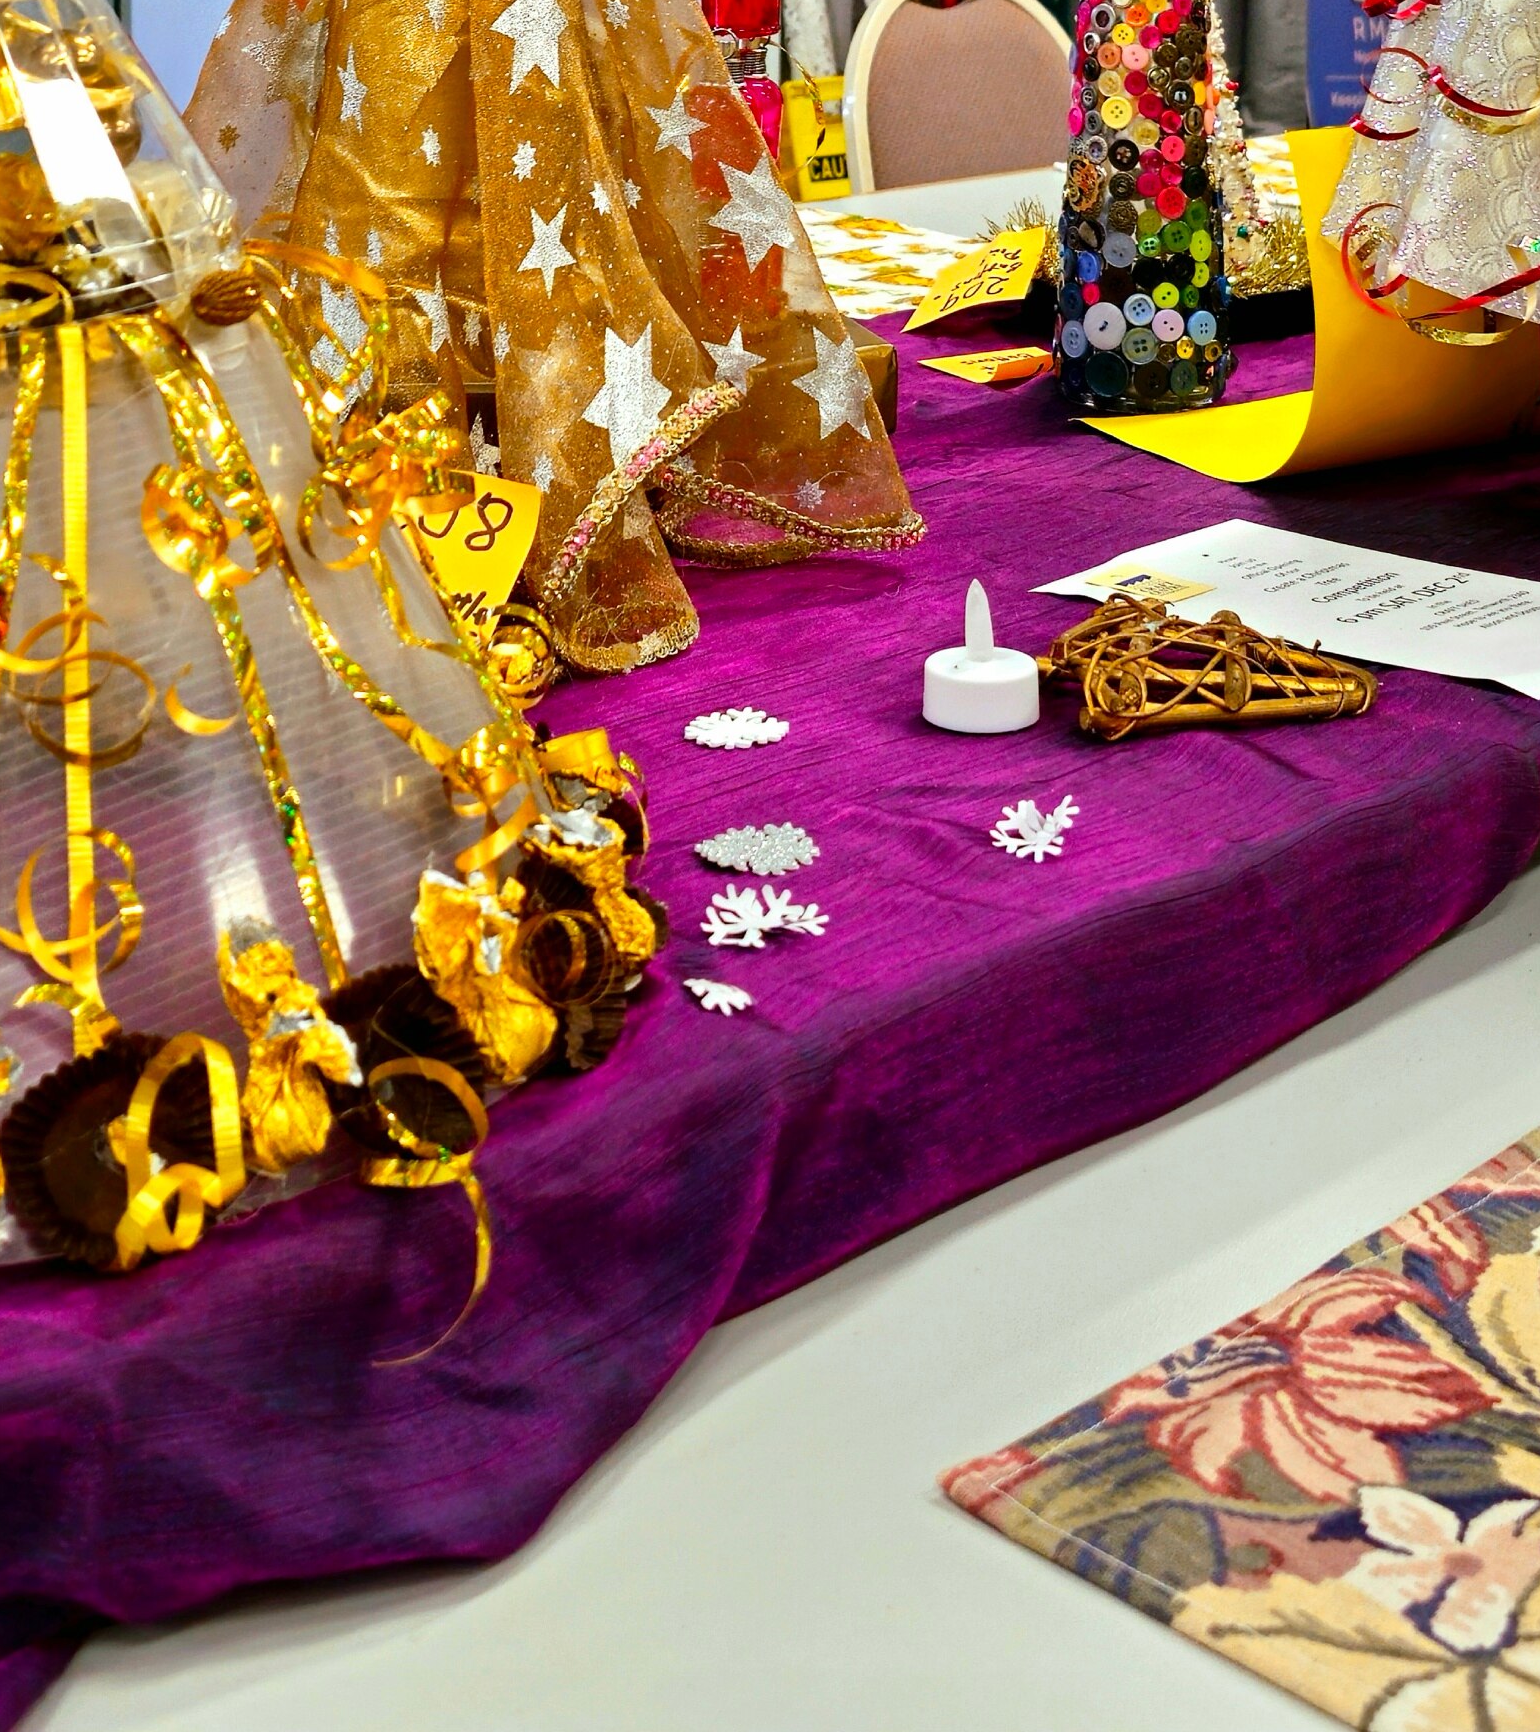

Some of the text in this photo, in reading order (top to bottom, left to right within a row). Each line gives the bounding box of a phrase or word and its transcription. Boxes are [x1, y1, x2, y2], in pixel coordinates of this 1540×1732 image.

[811, 156, 846, 180] CAU
[1263, 580, 1299, 593] Create
[1301, 562, 1350, 579] Christmas
[1311, 573, 1399, 603] Competition
[1314, 578, 1341, 586] Tree
[1354, 608, 1389, 620] pm
[1378, 595, 1423, 609] SAT.
[1411, 582, 1456, 597] DEC
